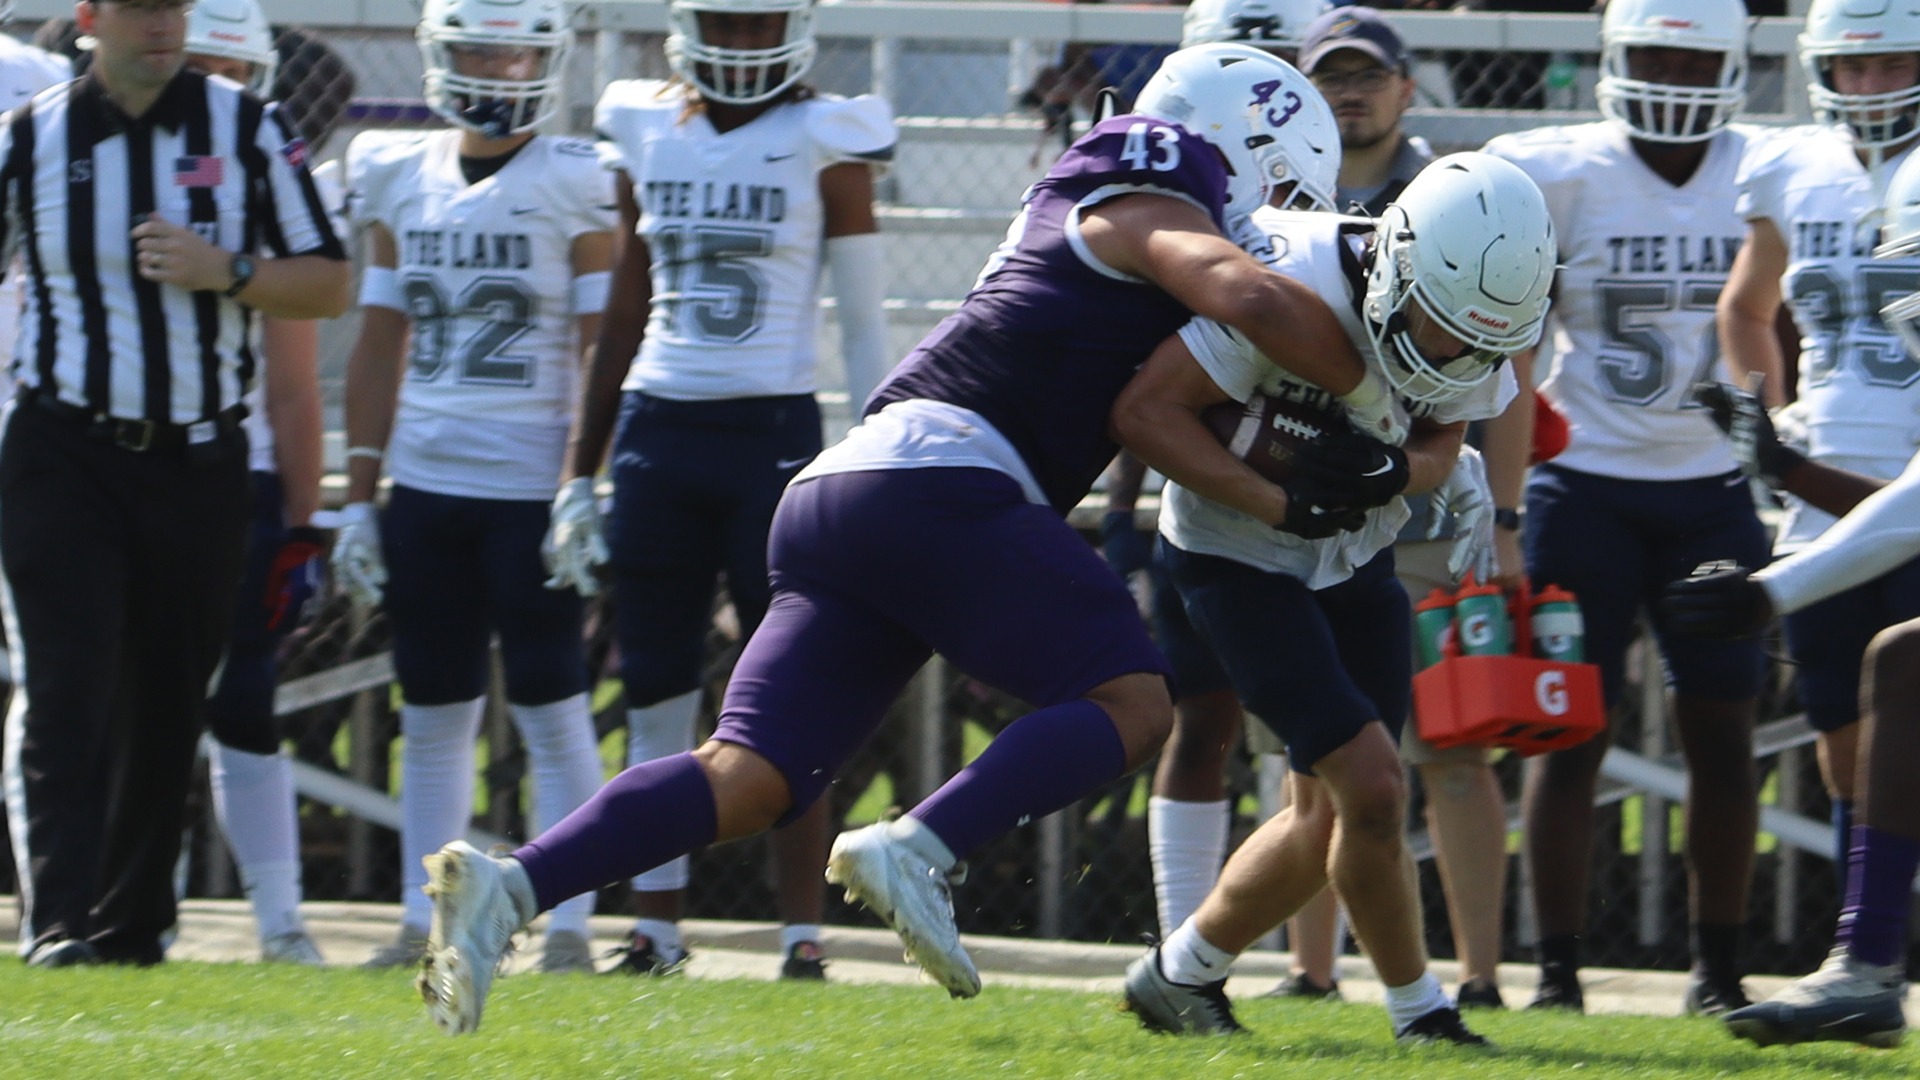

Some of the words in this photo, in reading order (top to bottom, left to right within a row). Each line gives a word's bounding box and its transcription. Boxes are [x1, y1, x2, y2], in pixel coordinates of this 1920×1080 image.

[1248, 80, 1302, 128] 43
[1119, 123, 1180, 171] 43
[647, 181, 692, 217] THE
[703, 182, 786, 222] LAND
[406, 229, 443, 266] THE
[453, 232, 530, 269] LAND
[1608, 236, 1667, 273] THE
[1678, 236, 1745, 272] LAN
[1797, 222, 1842, 257] THE
[655, 224, 774, 343] 15
[1468, 310, 1510, 330] Riddell
[1461, 613, 1494, 647] G
[1534, 671, 1570, 716] G
